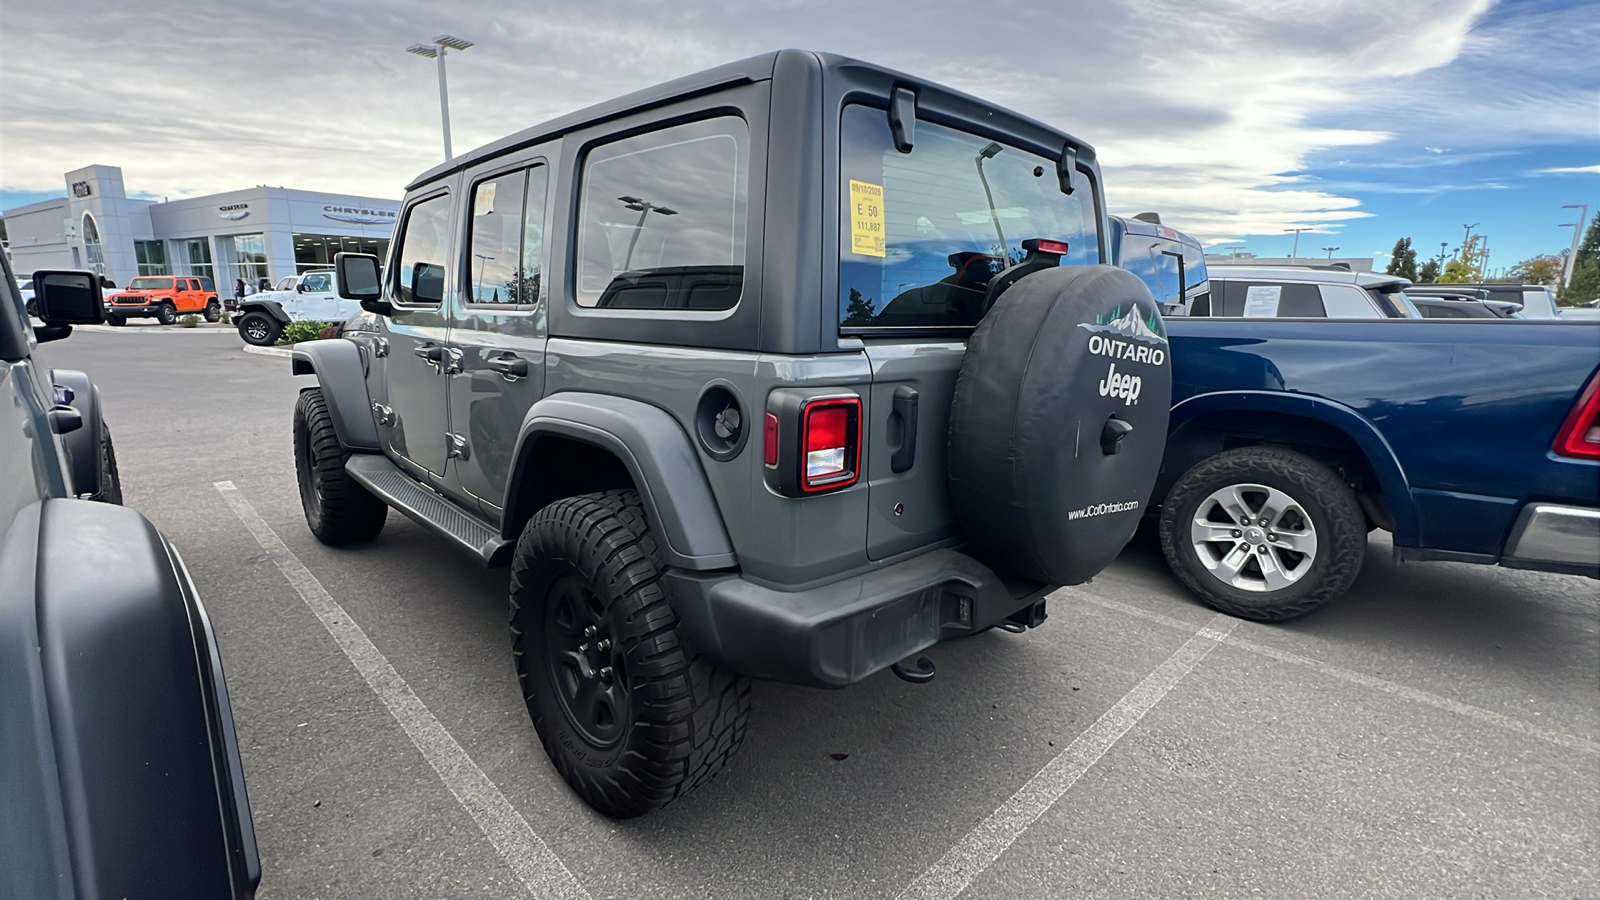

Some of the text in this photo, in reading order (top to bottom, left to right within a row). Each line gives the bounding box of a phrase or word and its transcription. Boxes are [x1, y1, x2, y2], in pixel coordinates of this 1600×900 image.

[323, 205, 396, 217] CHRYSLER
[858, 204, 878, 218] E 50
[857, 221, 880, 232] 111,887
[1088, 335, 1164, 366] ONTARIO
[1099, 363, 1141, 405] Jeep
[1068, 501, 1138, 520] www.JCofOntario.com
